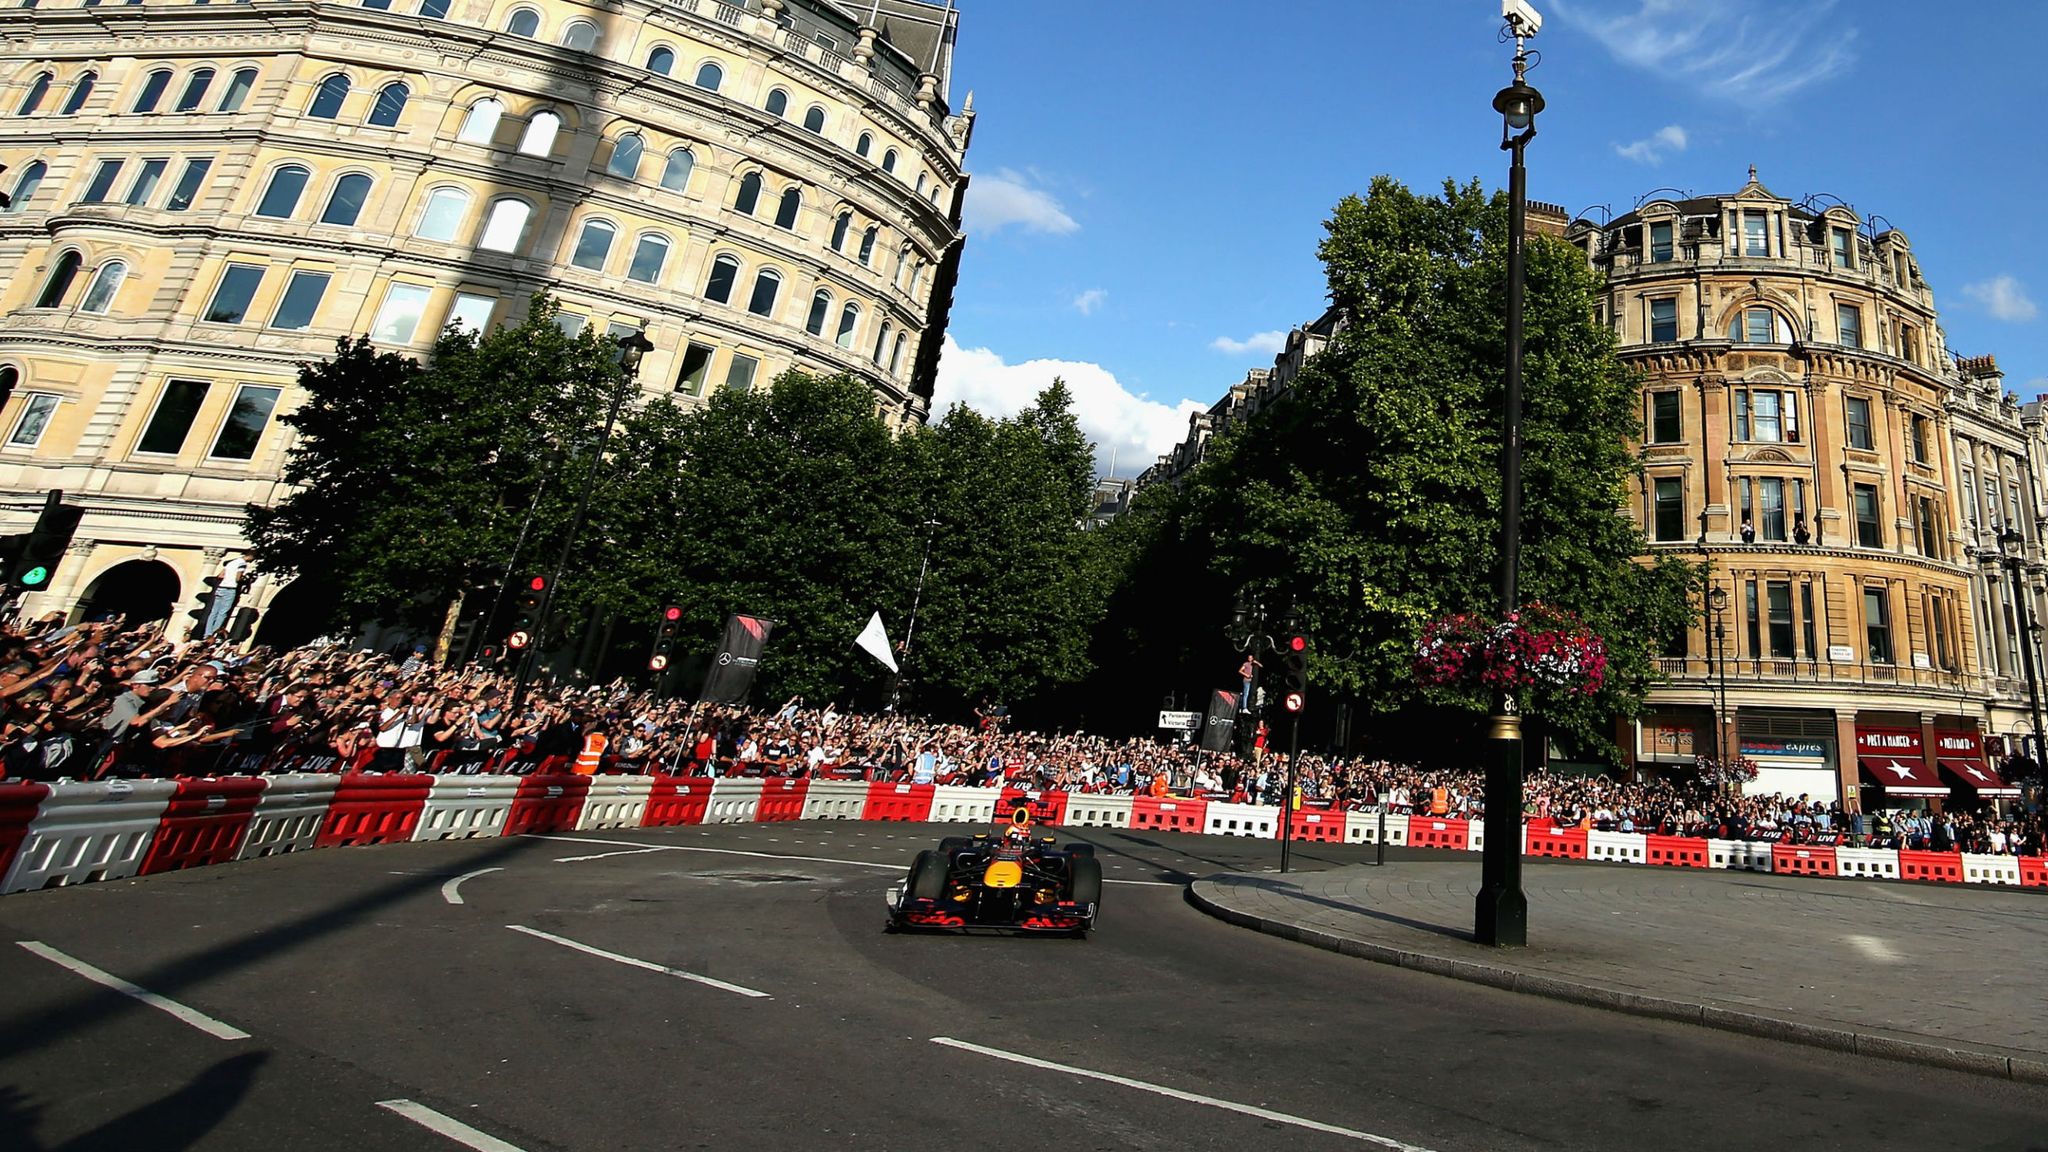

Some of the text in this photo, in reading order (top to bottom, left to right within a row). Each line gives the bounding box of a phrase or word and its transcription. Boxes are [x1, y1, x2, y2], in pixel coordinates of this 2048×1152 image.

[300, 755, 337, 770] LIVE
[1762, 829, 1783, 839] LIVE
[1817, 834, 1837, 843] LIVE
